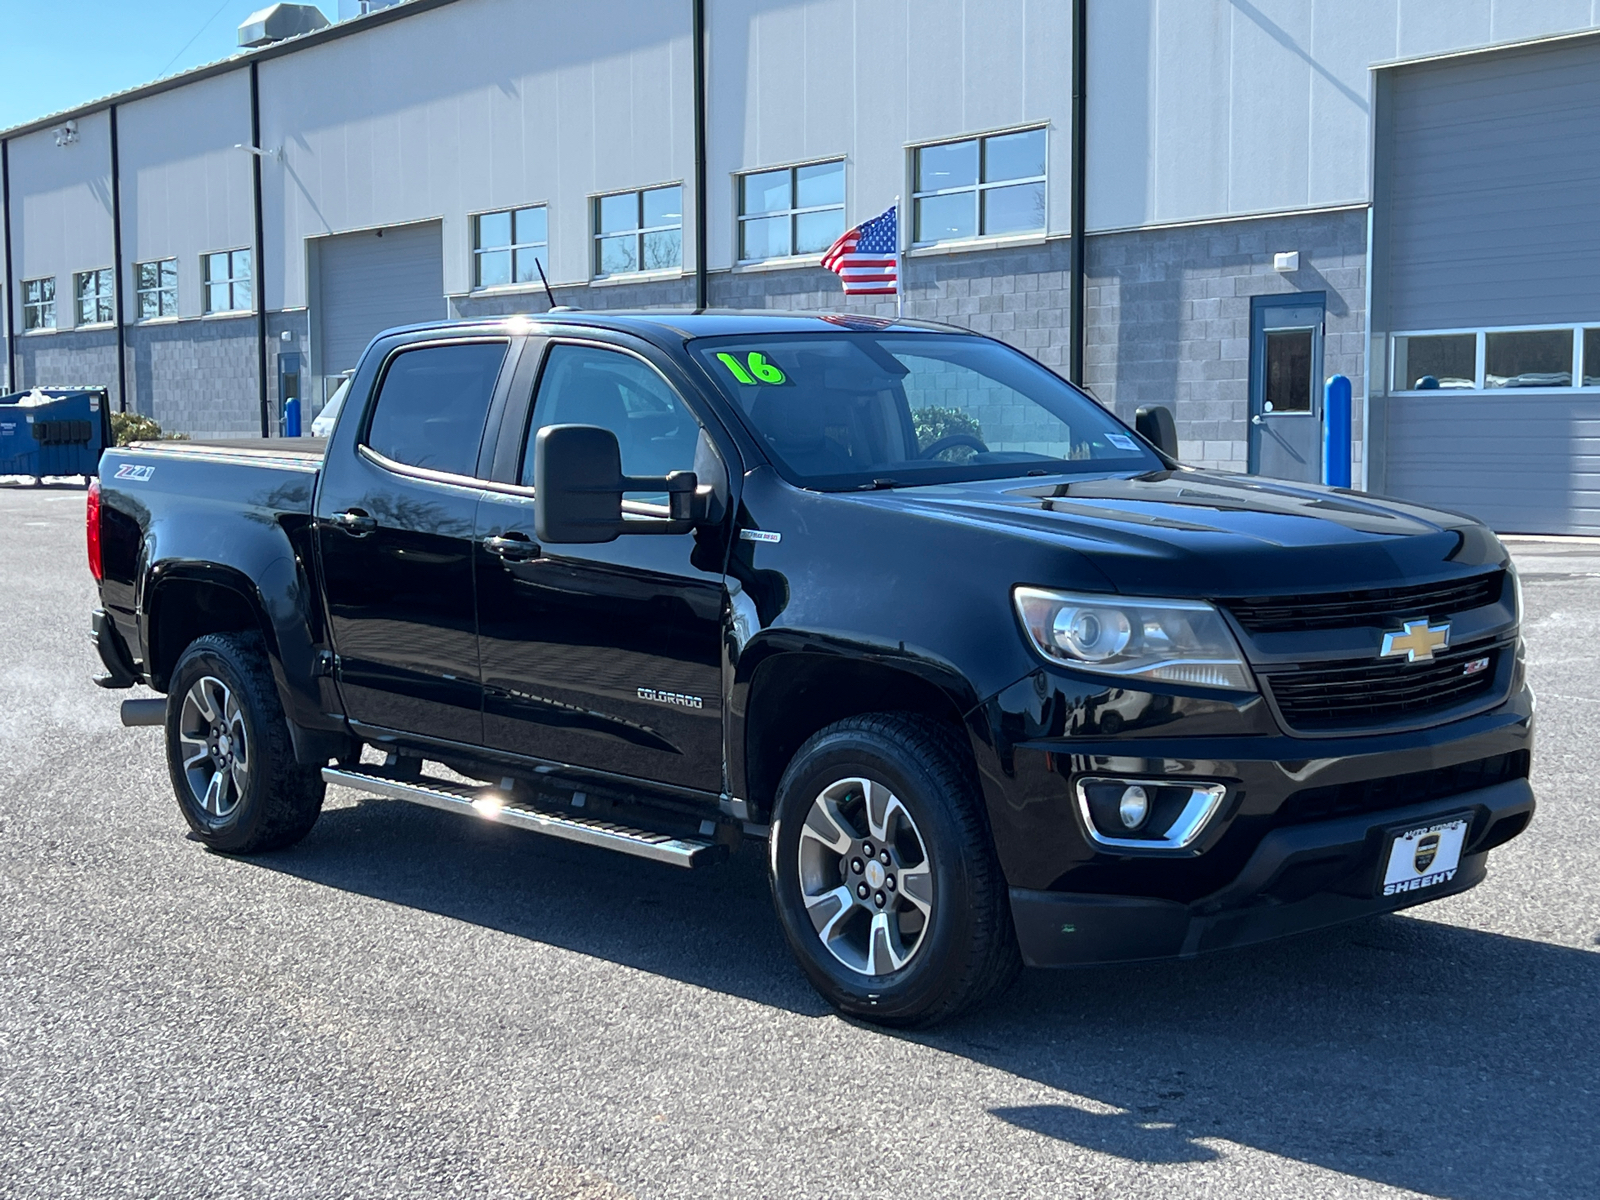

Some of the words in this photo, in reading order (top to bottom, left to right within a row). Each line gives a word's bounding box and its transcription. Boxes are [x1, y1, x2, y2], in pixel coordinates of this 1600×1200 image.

[716, 352, 786, 385] 16
[113, 463, 156, 482] Z71
[637, 687, 703, 709] COLORADO
[1383, 869, 1458, 896] SHEEHY
